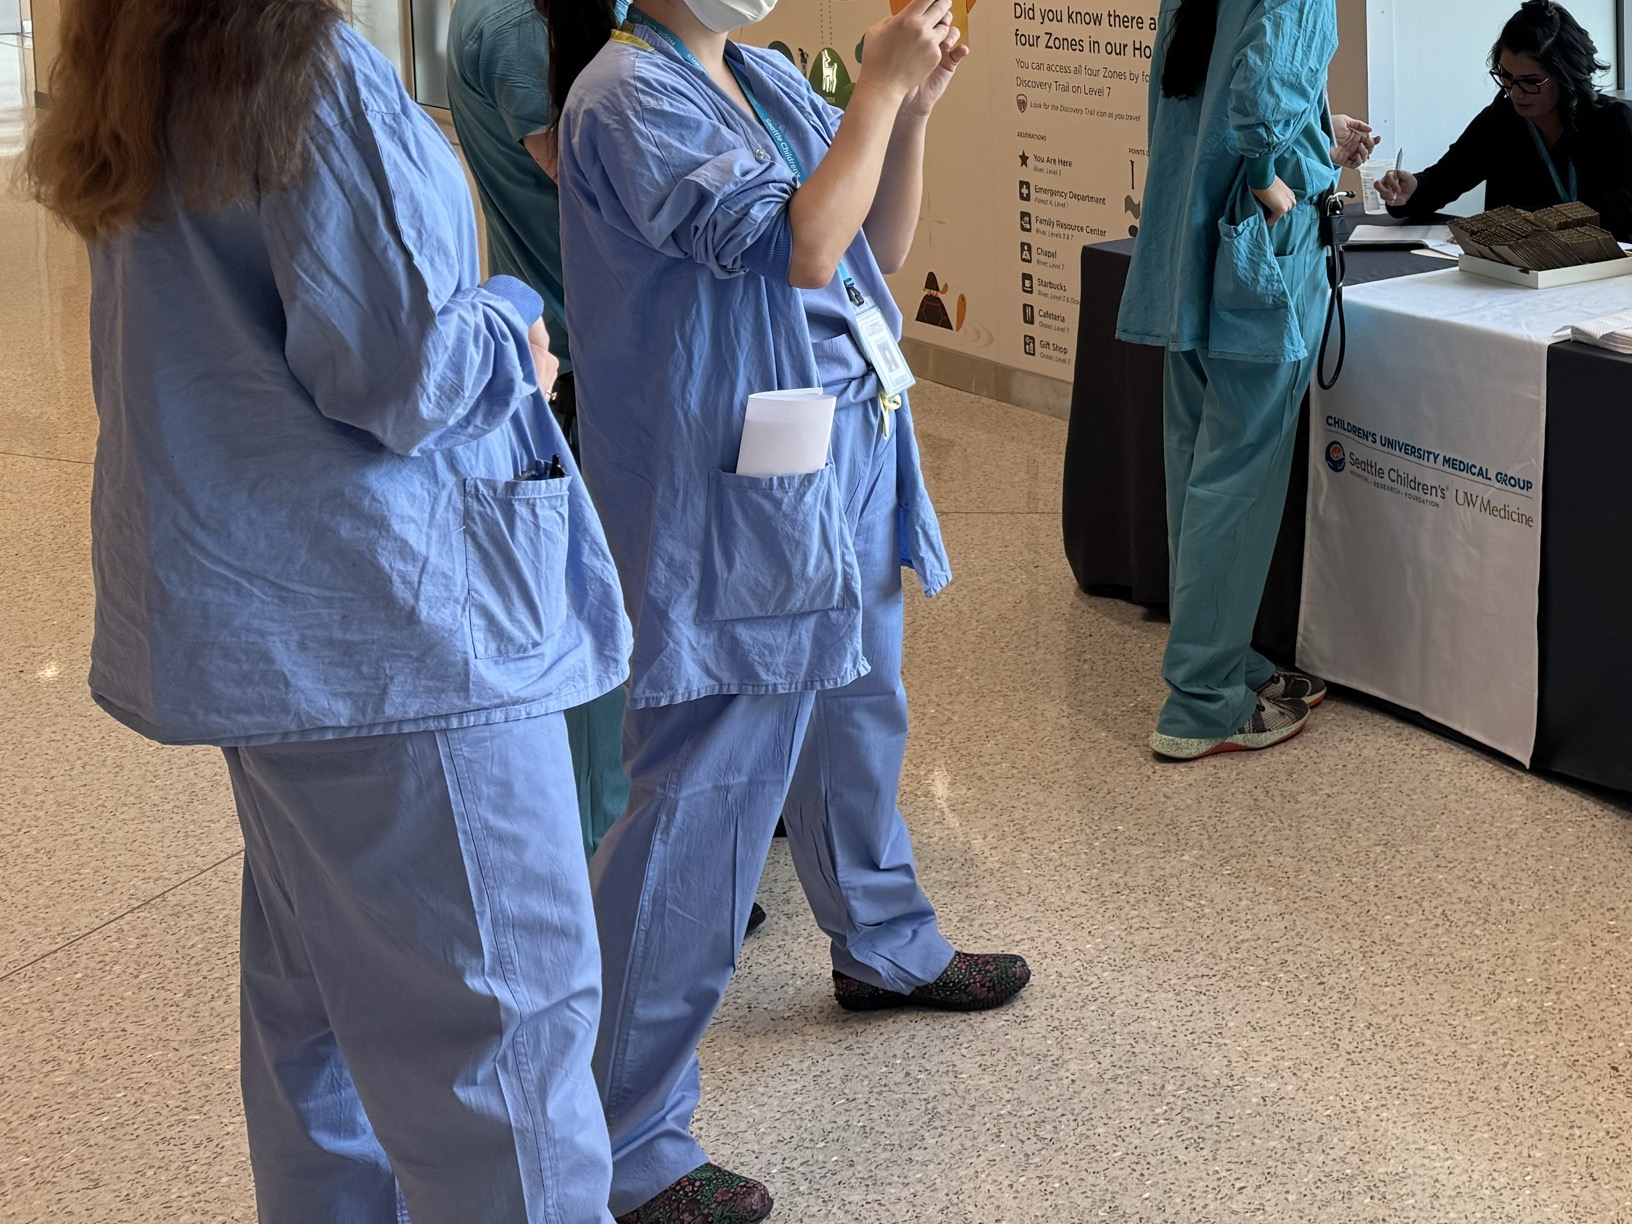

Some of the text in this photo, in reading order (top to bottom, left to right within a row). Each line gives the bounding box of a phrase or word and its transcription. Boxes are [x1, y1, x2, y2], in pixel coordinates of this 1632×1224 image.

[1013, 2, 1036, 21] Did
[1039, 7, 1063, 25] you
[1067, 5, 1103, 27] know
[1107, 9, 1145, 30] there
[1014, 28, 1041, 48] four
[1044, 32, 1085, 53] Zones
[1088, 35, 1101, 54] in
[1104, 41, 1128, 57] our
[1015, 58, 1030, 70] You
[1031, 60, 1045, 72] can
[1046, 62, 1072, 75] access
[1073, 64, 1083, 76] all
[1084, 64, 1101, 78] four
[1102, 67, 1127, 81] Zones
[1128, 70, 1140, 84] by
[1015, 76, 1112, 98] Discovery Trail on Level 7
[1029, 101, 1042, 109] Look
[1050, 103, 1059, 112] the
[1059, 104, 1084, 116] Discovery
[1084, 107, 1096, 116] Trail
[1107, 111, 1114, 119] as
[1114, 113, 1125, 121] you
[1125, 113, 1141, 122] travel
[1032, 153, 1073, 168] You Are Here
[1034, 184, 1107, 206] Emergency Department
[1035, 216, 1107, 237] Family Resource Center
[1036, 247, 1057, 259] Chapel
[1037, 277, 1067, 292] Starbucks
[1038, 309, 1066, 323] Cafeteria
[1039, 339, 1068, 355] Gift Shop
[1325, 415, 1533, 492] CHILDREN'S UNIVERSITY MEDICAL GROUP
[1349, 452, 1446, 500] Seattle Children's
[1454, 488, 1534, 528] UW Medicine
